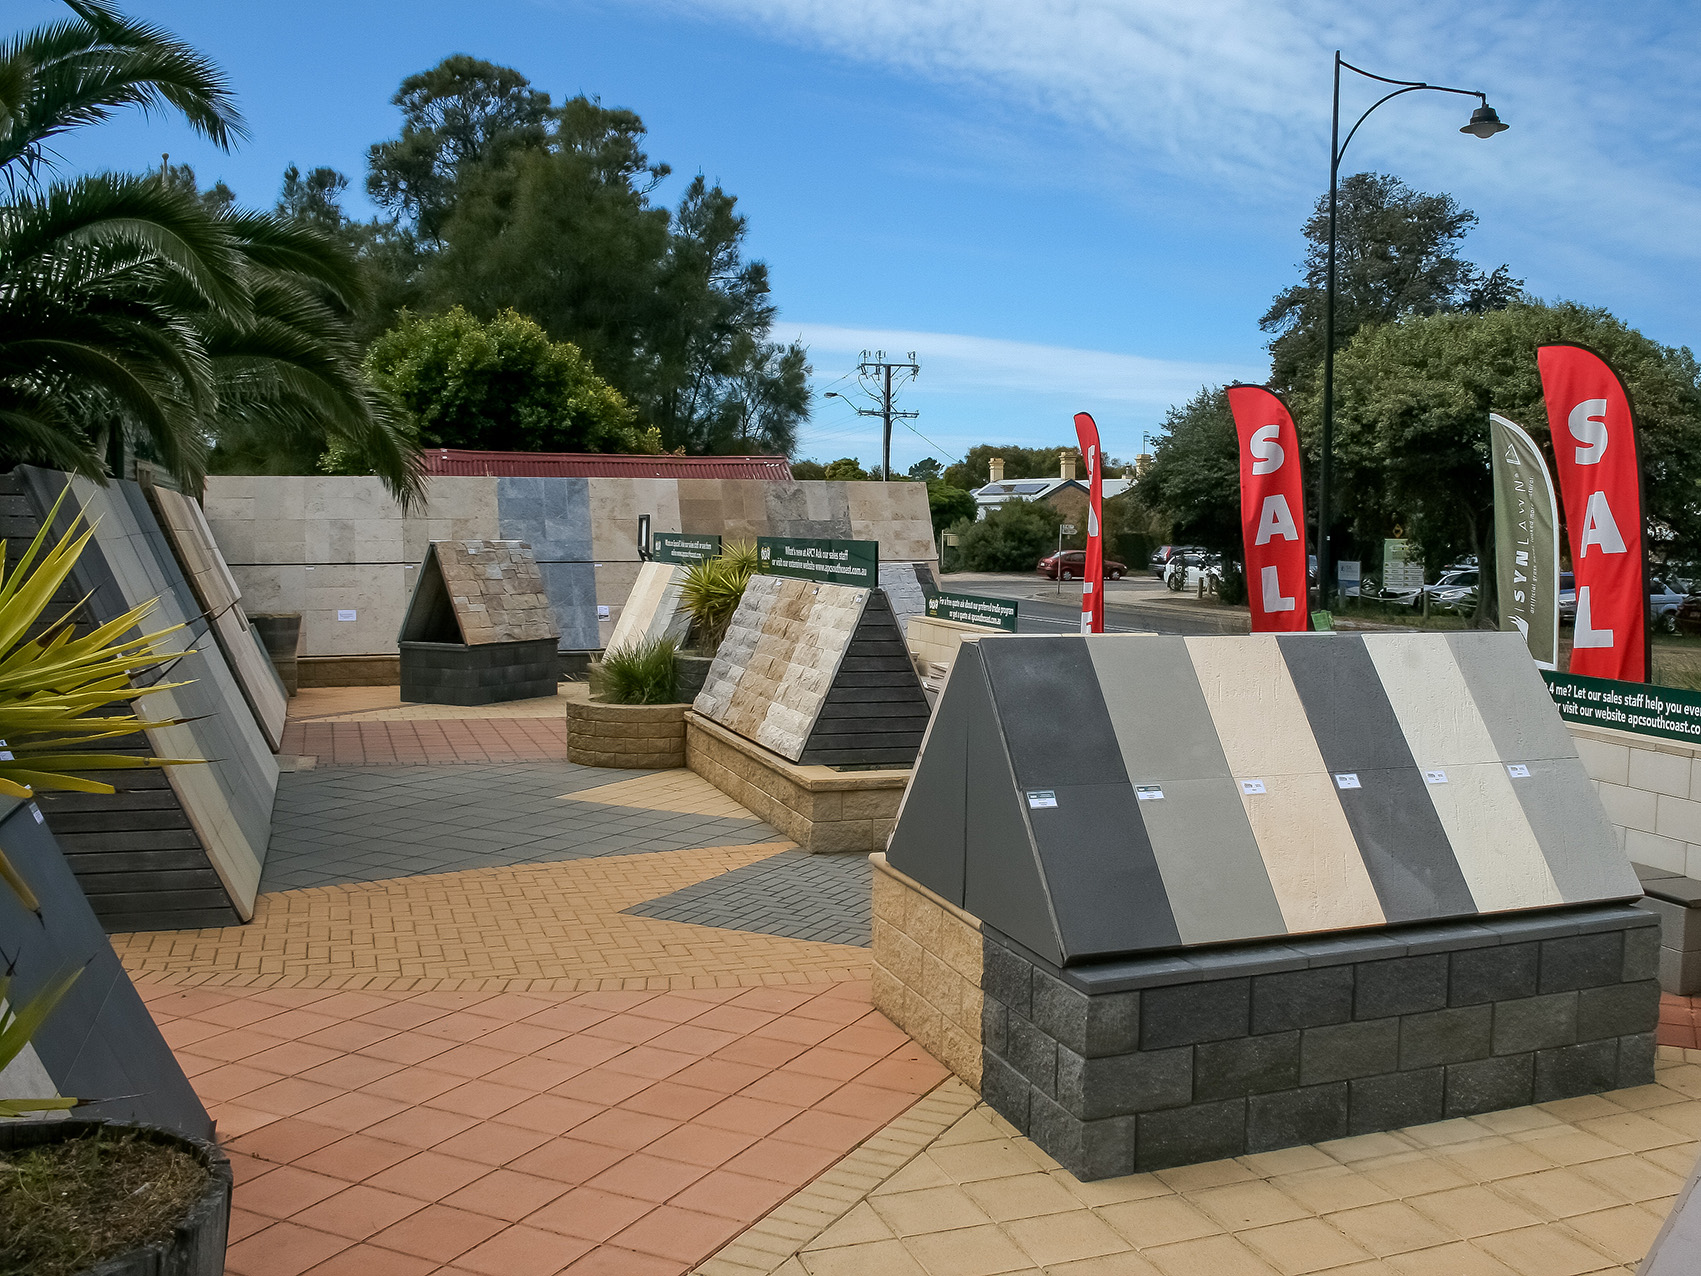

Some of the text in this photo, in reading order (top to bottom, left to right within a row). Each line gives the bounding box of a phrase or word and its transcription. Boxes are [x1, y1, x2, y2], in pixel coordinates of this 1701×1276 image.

[1250, 424, 1299, 613] SAL
[1568, 398, 1628, 649] SAL
[1529, 583, 1537, 614] artificial
[1549, 682, 1555, 694] 4
[1555, 684, 1572, 697] me?
[1573, 685, 1586, 699] Let
[1587, 690, 1601, 701] our
[1602, 689, 1623, 705] sales
[1624, 693, 1644, 708] staff
[1645, 696, 1664, 715] help
[1665, 701, 1682, 716] you
[1683, 705, 1701, 717] eve
[1562, 700, 1578, 715] visit
[1579, 706, 1593, 717] our
[1594, 706, 1627, 722] website
[1627, 713, 1701, 735] apcsouthcoast.co
